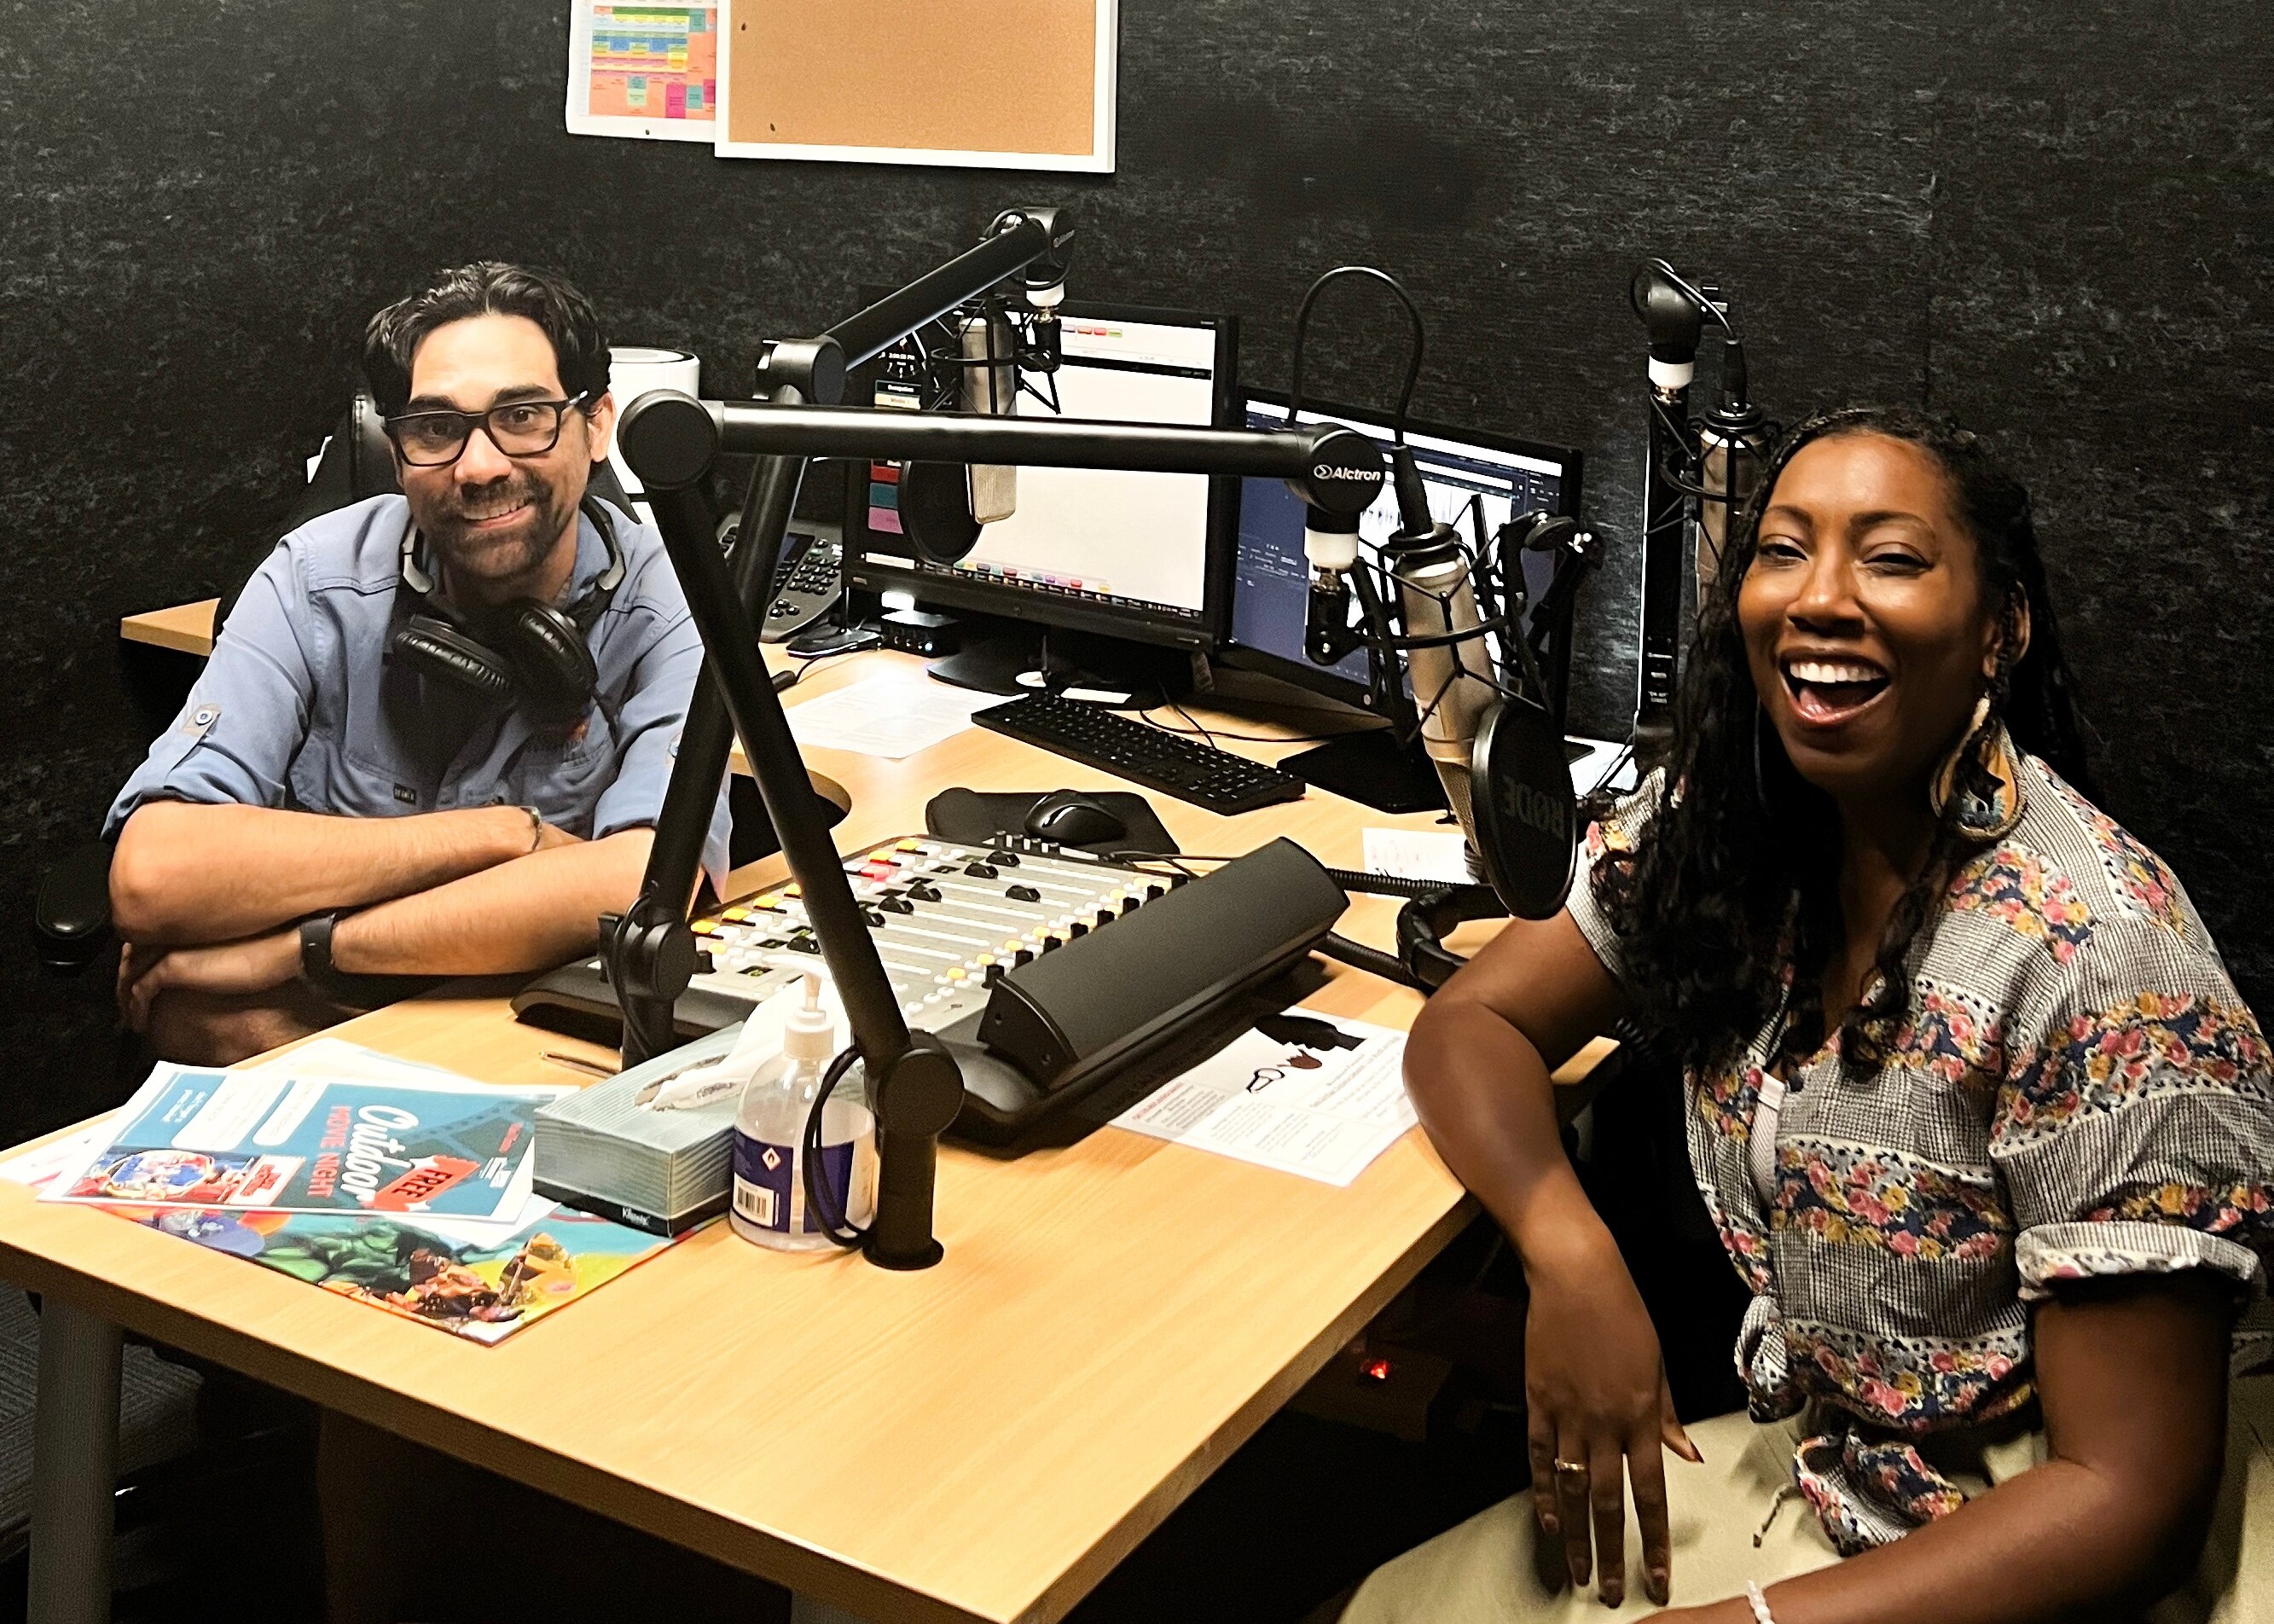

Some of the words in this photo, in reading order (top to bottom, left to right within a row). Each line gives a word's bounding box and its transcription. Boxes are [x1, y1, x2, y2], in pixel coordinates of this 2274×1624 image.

[1332, 467, 1381, 481] Alctron
[319, 1105, 352, 1150] MOVIE
[307, 1151, 341, 1198] NIGHT
[339, 1105, 420, 1203] Outdoor
[391, 1168, 454, 1199] FREE
